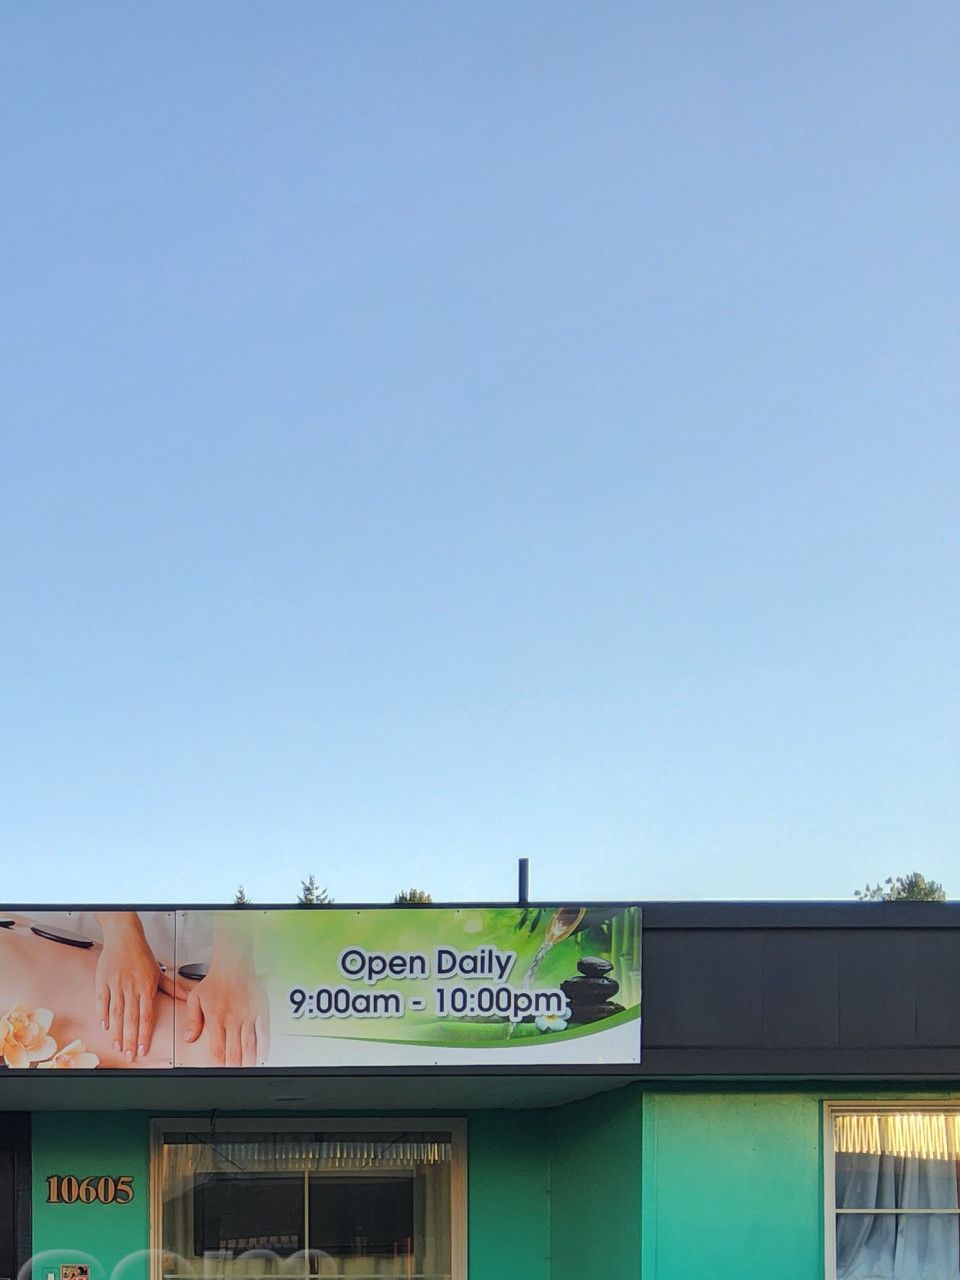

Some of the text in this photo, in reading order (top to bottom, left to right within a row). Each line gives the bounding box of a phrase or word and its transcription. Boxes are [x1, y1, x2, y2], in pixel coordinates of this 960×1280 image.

[341, 949, 513, 980] Open Daily
[289, 988, 401, 1015] 9:00am
[436, 988, 564, 1019] 10:00pm
[46, 1174, 135, 1204] 10605
